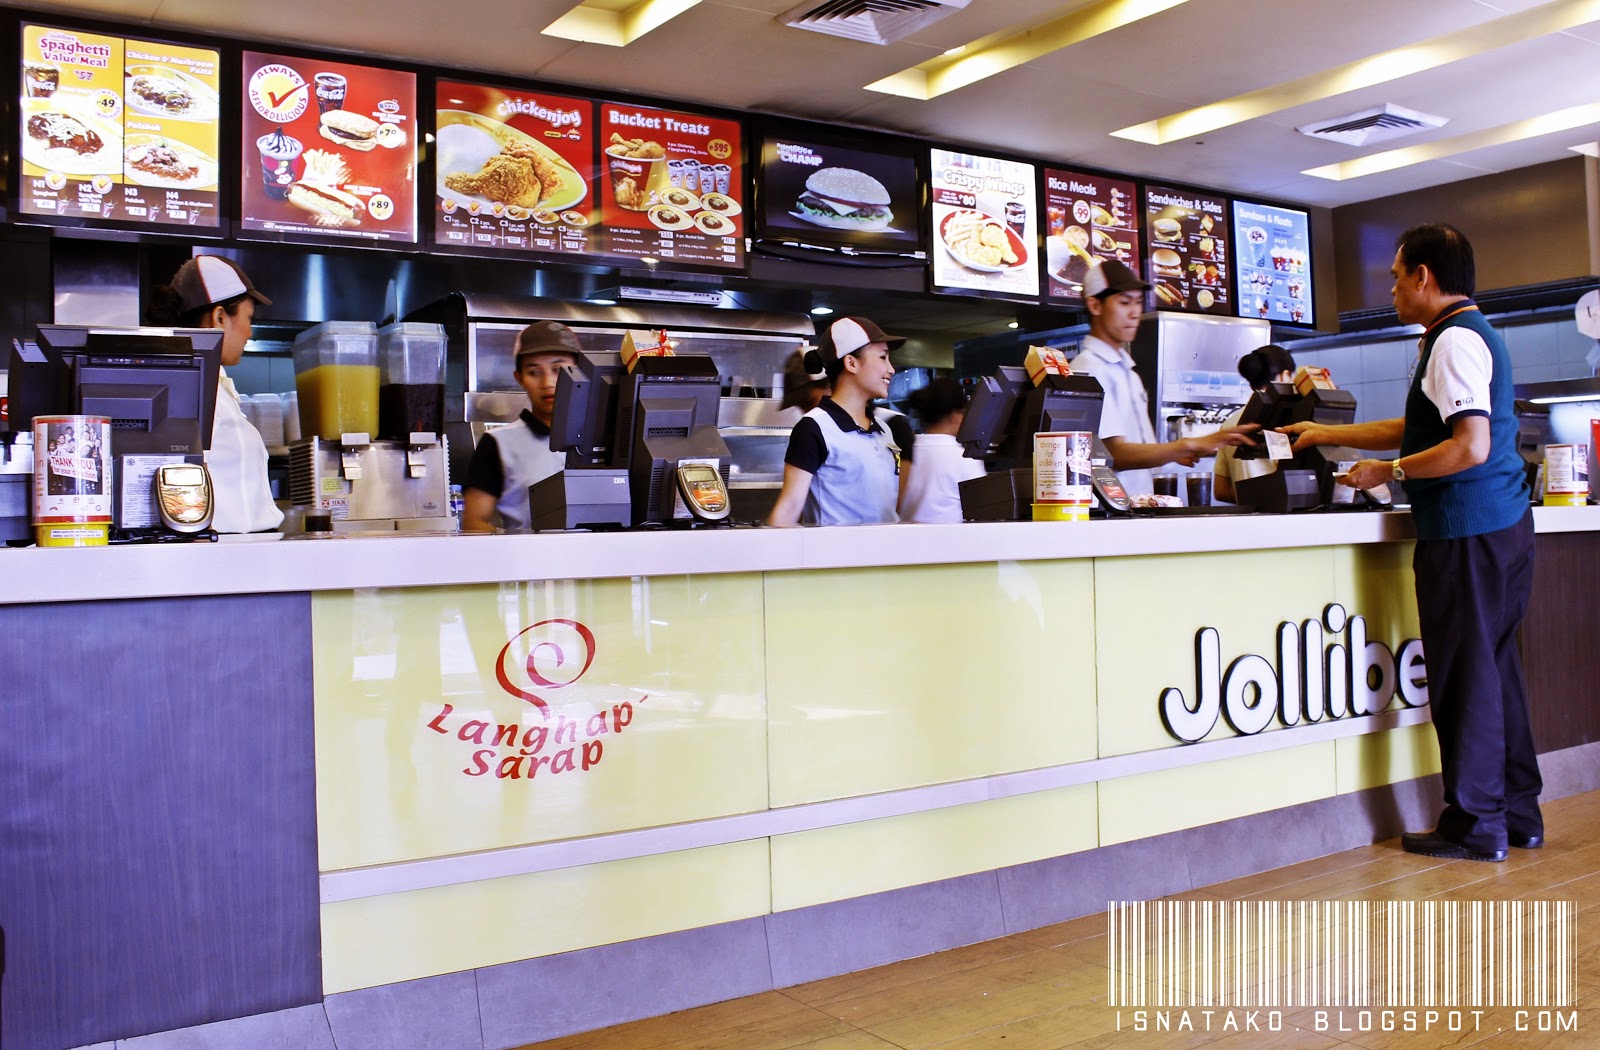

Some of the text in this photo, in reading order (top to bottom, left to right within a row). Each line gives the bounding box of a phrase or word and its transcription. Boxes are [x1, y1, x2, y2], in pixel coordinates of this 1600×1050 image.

[41, 38, 109, 56] Spaghetti
[44, 52, 106, 67] Value Meal
[126, 51, 160, 62] Chicken
[170, 57, 215, 68] Mushroom
[190, 66, 213, 75] Pasta
[256, 66, 301, 85] ALWAYS
[251, 89, 307, 121] AFFORDELICIOUS
[496, 98, 581, 127] Chickenjoy
[609, 110, 710, 135] Bucket Treats
[781, 153, 823, 166] CHAMP
[33, 180, 45, 188] N1
[79, 184, 92, 193] N2
[124, 187, 138, 196] N3
[943, 169, 985, 193] Crispy
[985, 176, 1025, 199] Wings
[1048, 177, 1097, 196] Rice Meals
[166, 191, 179, 199] N4
[1148, 191, 1222, 214] Sandwiches & Sides
[51, 456, 74, 468] THANK
[1159, 602, 1429, 743] Jollibe
[463, 739, 603, 779] Sarap
